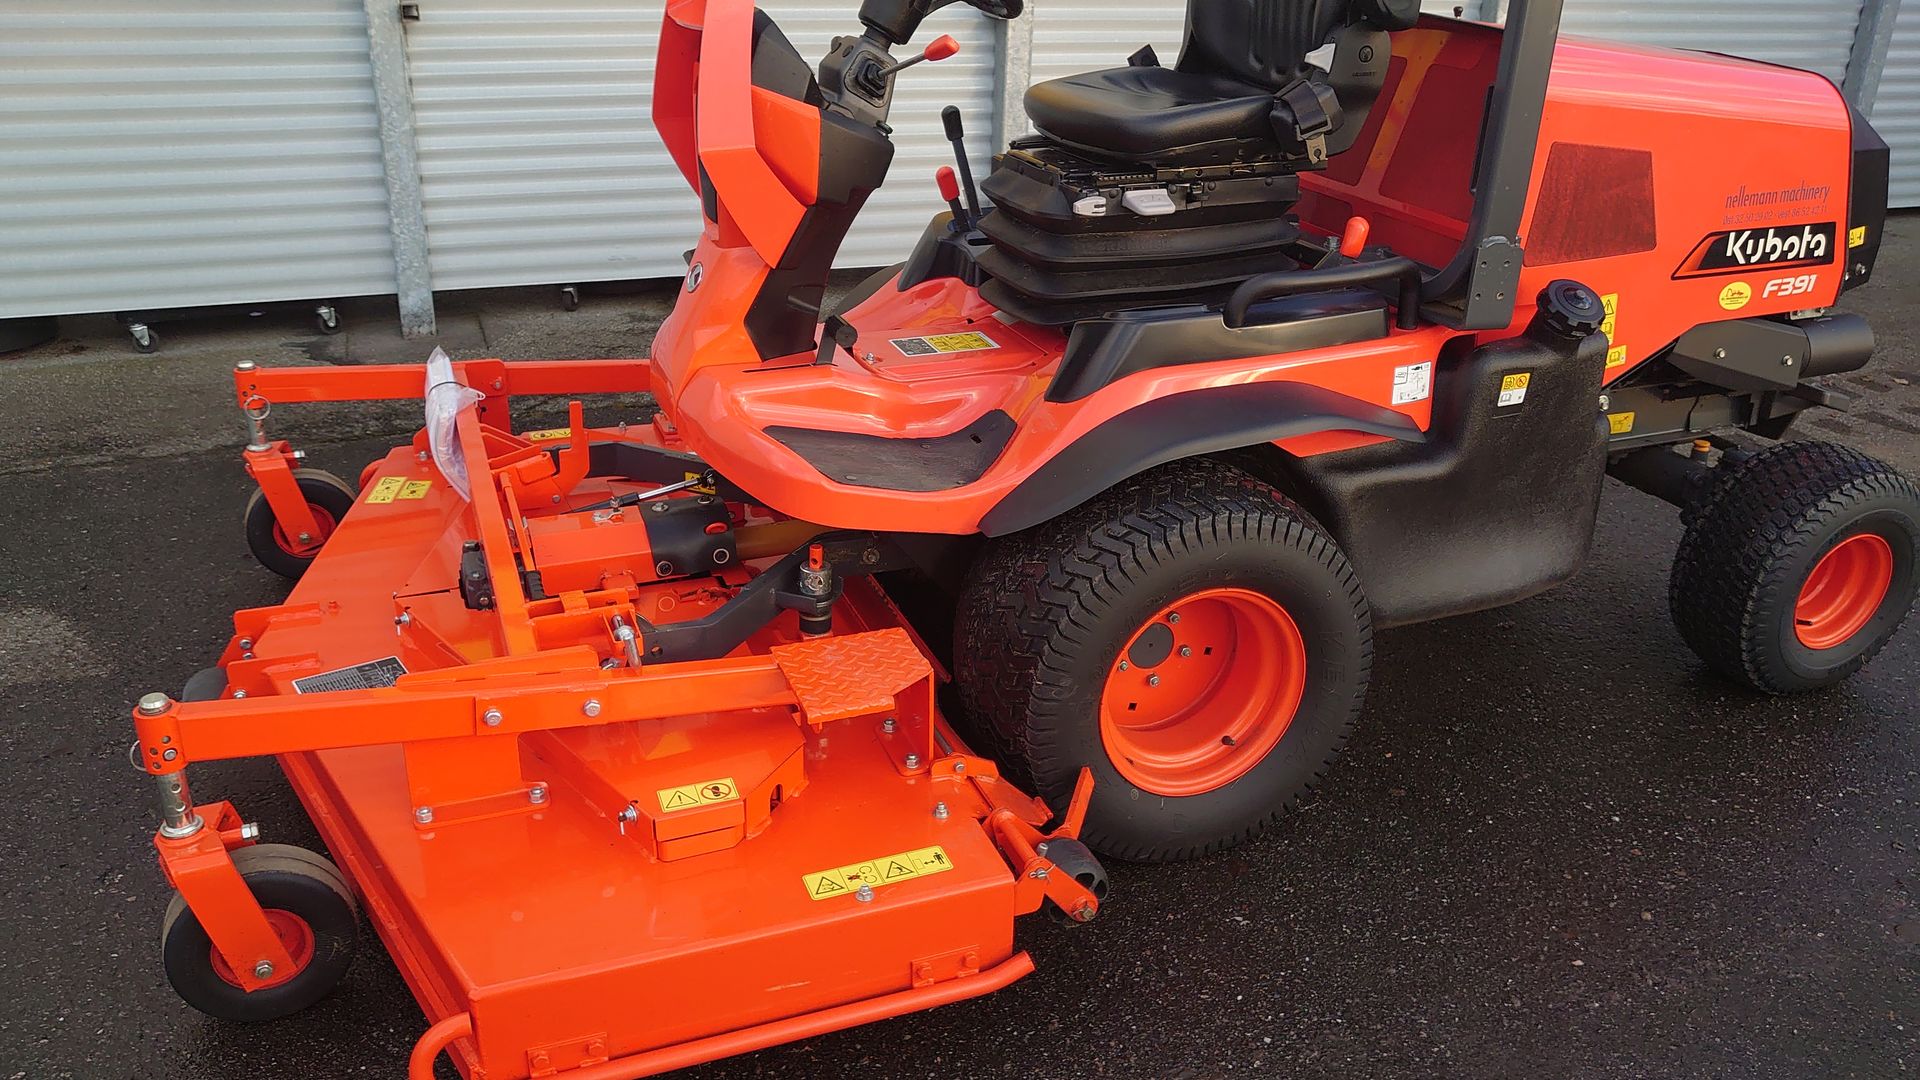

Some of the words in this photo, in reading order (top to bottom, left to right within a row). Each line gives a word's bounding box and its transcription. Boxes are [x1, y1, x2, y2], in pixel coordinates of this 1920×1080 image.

[1725, 185, 1778, 208] nellemann
[1780, 180, 1830, 203] machinery
[1726, 225, 1826, 264] Kubota
[1762, 274, 1817, 299] F391
